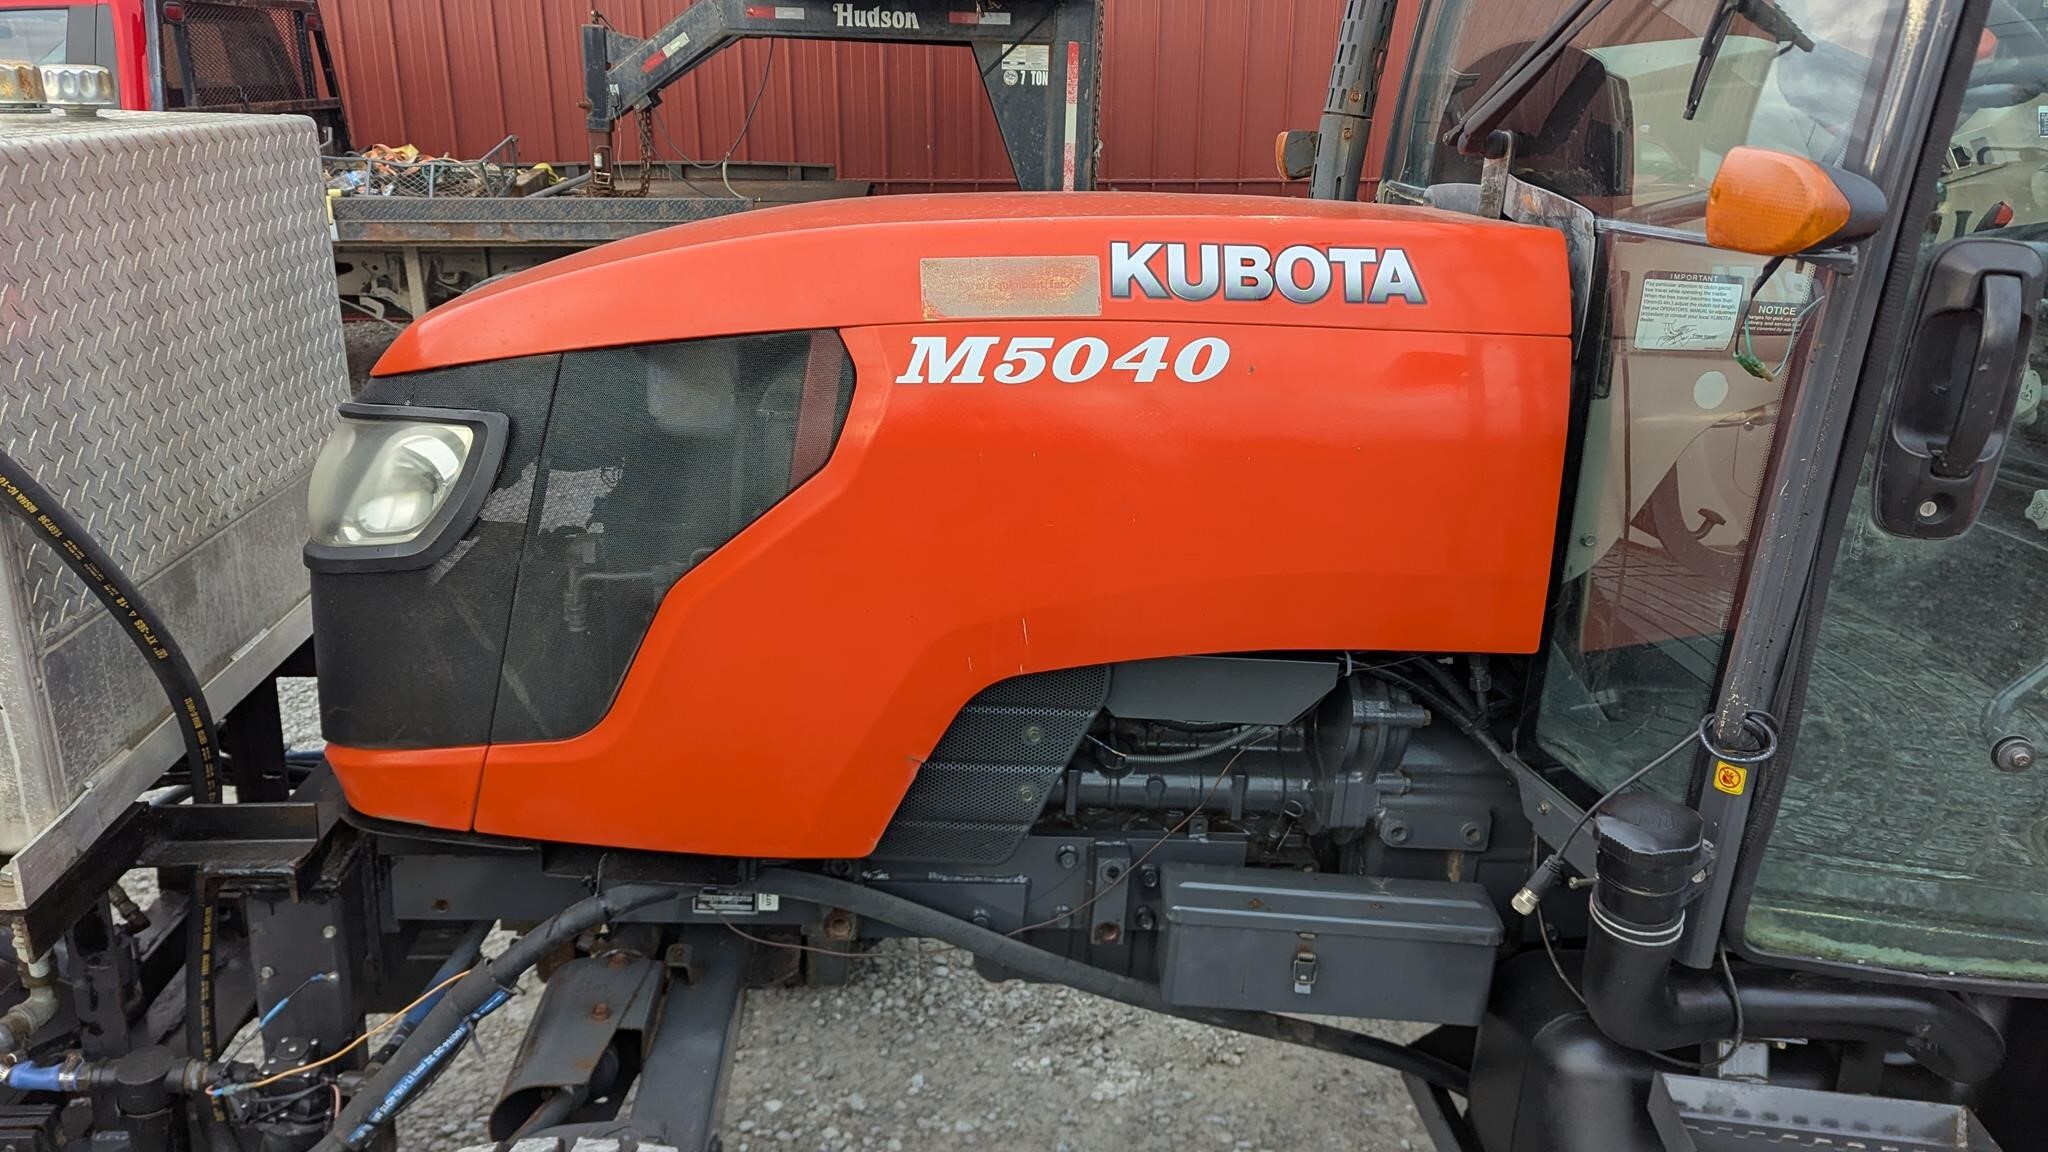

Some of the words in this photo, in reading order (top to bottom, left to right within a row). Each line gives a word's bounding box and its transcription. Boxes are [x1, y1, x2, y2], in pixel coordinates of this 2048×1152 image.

[832, 3, 920, 29] Hudson
[1020, 70, 1026, 85] 7
[1030, 70, 1049, 86] TON
[1110, 241, 1427, 304] KUBOTA
[1670, 273, 1719, 282] IMPORTANT
[1758, 305, 1797, 316] NOTICE
[895, 336, 1231, 384] M5040
